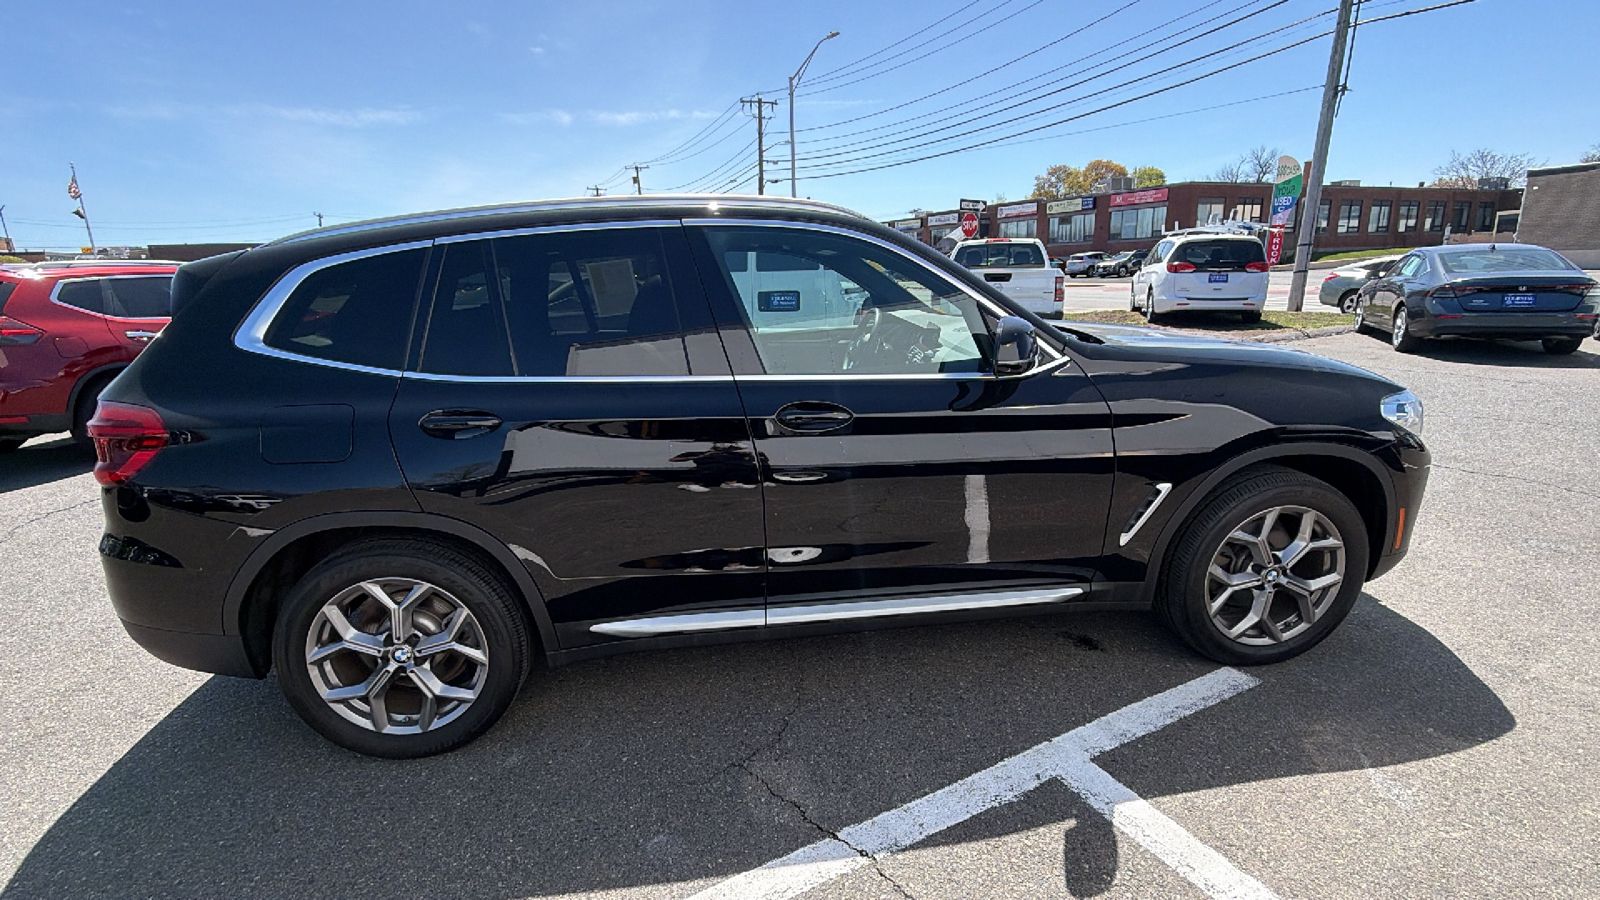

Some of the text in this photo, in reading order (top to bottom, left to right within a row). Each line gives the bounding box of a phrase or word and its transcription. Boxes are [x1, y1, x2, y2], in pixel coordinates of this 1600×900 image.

[1277, 185, 1296, 196] YOUR
[1274, 197, 1292, 206] USED
[1276, 206, 1285, 226] CAR
[962, 220, 977, 231] STOP
